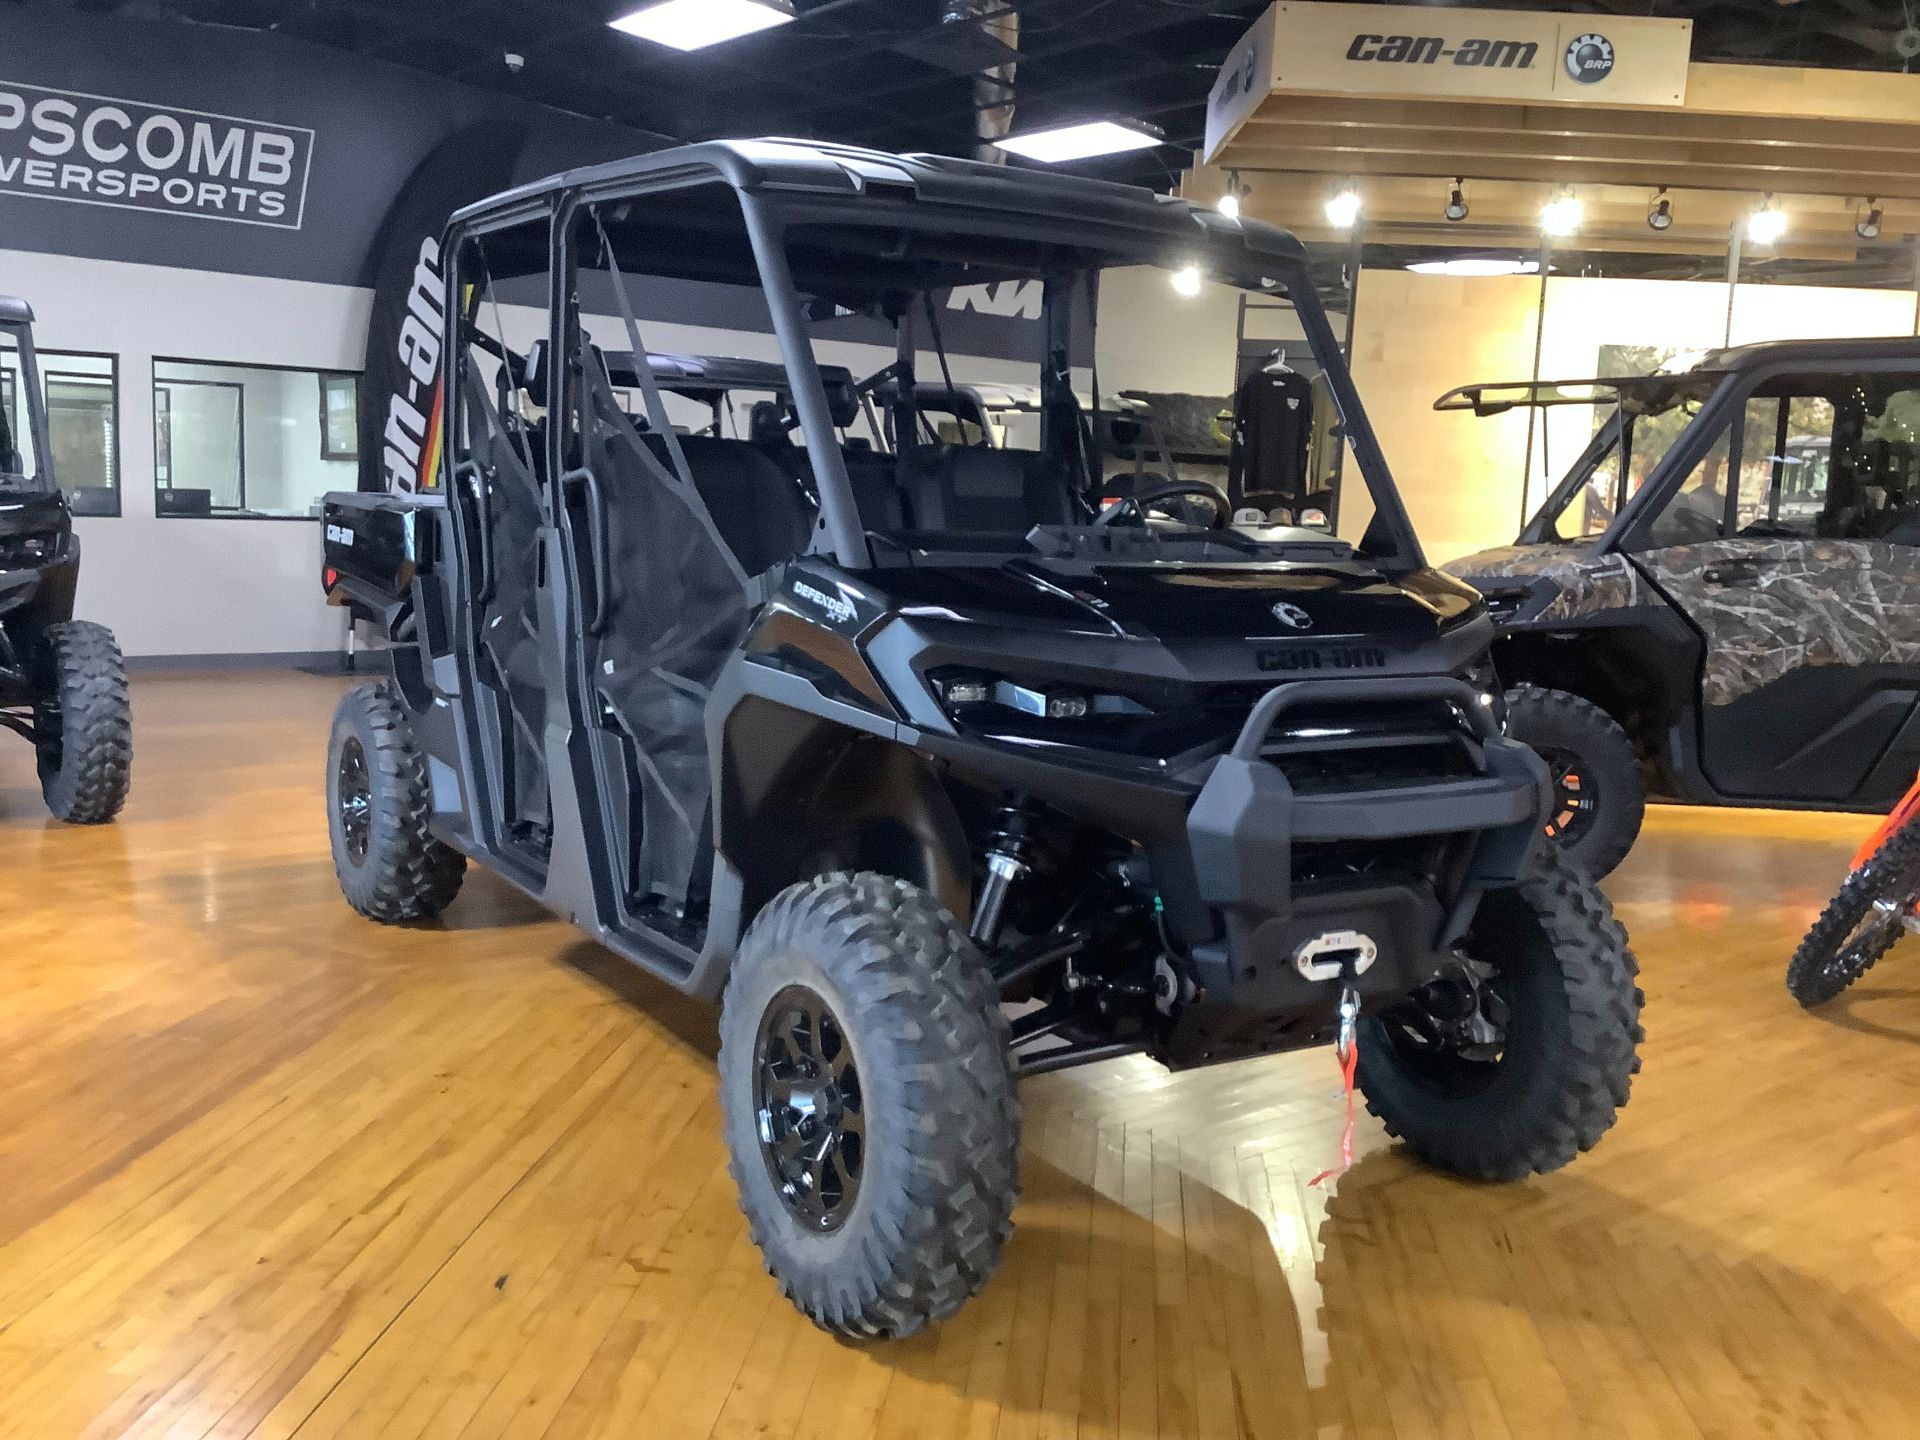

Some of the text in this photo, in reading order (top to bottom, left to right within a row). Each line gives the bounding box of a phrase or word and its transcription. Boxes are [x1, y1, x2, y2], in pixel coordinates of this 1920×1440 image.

[1346, 34, 1538, 68] can-am
[1583, 59, 1613, 71] BRP
[793, 581, 853, 616] DEFENDER
